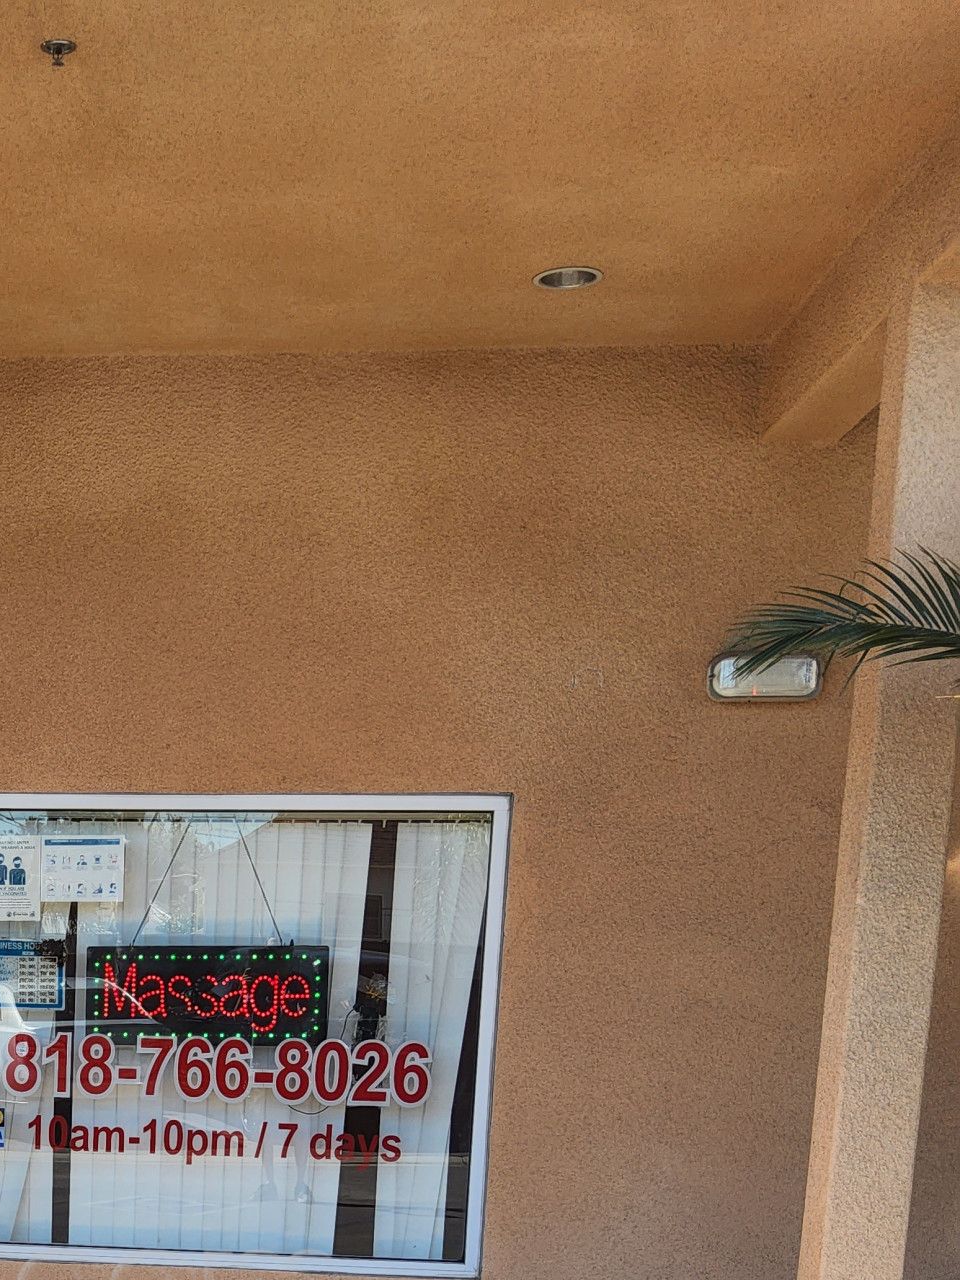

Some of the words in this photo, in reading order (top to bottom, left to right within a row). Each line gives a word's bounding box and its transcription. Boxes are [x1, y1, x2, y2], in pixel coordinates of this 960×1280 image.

[104, 962, 310, 1032] Massage
[5, 1031, 431, 1105] 818-766-8026
[27, 1114, 244, 1165] 10am-10pm
[253, 1121, 268, 1158] /
[278, 1123, 299, 1159] 7
[309, 1124, 402, 1170] days
